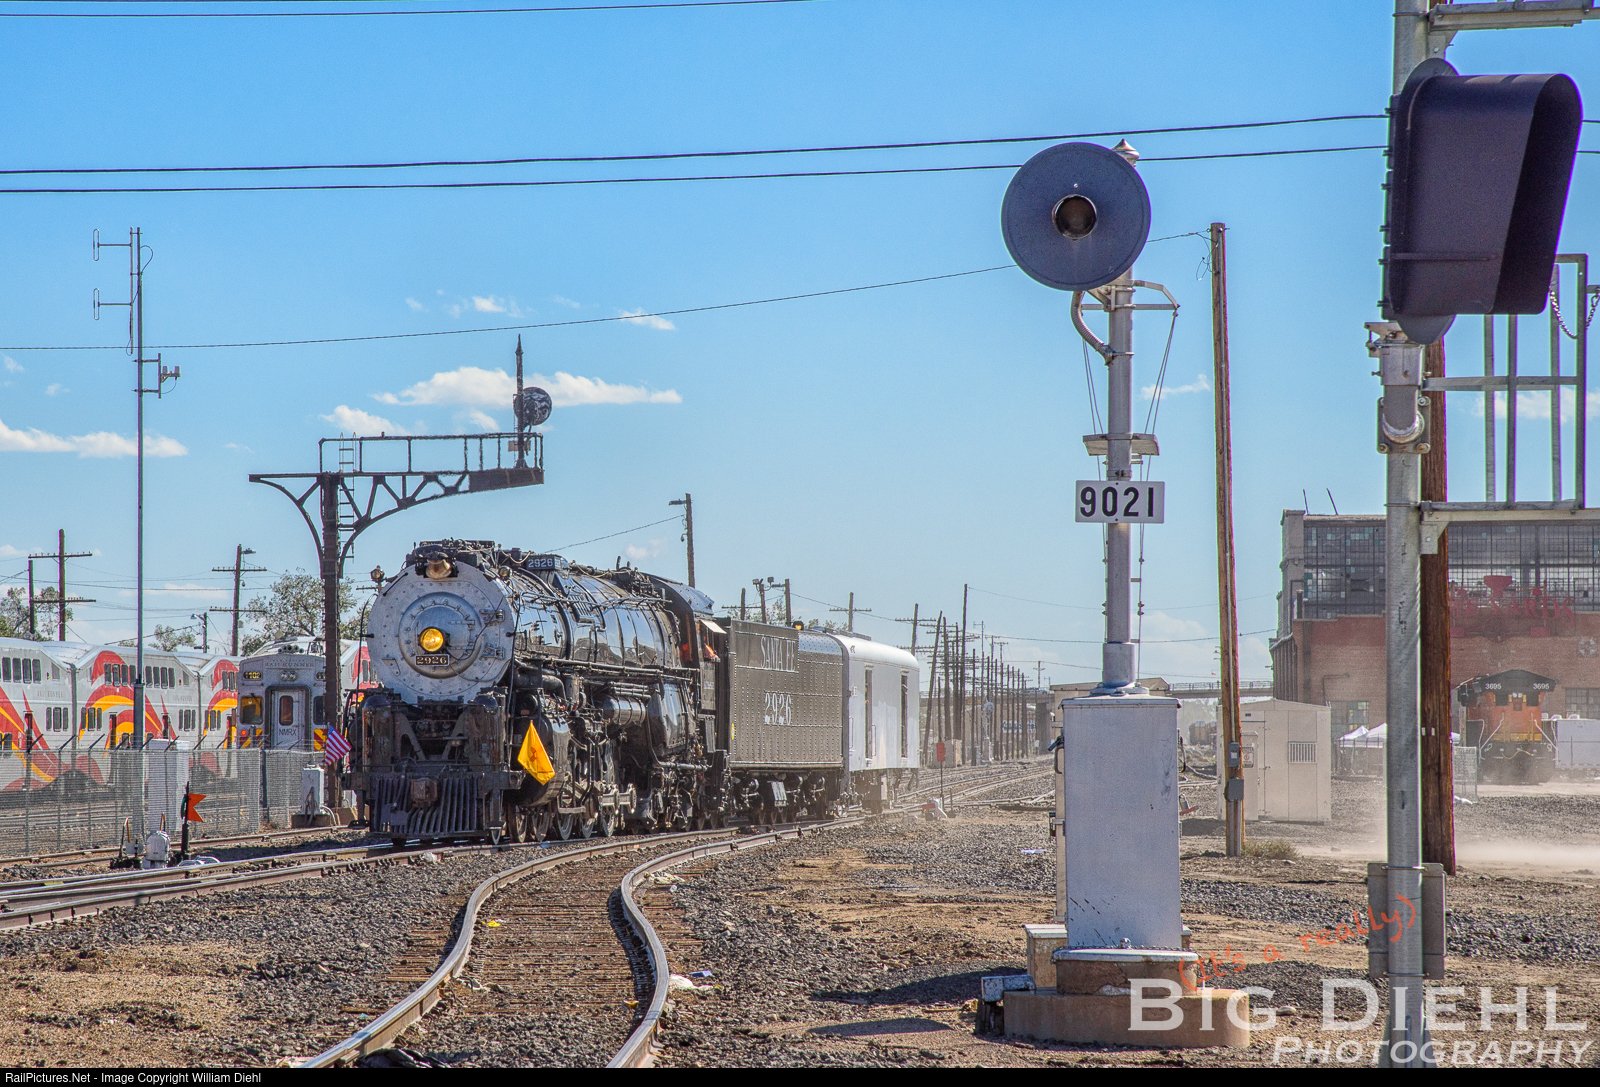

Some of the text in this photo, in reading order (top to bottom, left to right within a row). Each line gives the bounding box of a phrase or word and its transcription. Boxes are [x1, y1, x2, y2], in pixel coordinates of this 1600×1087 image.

[1079, 486, 1154, 517] 9021
[416, 656, 447, 665] 2926
[761, 636, 796, 672] SANTA FE
[763, 692, 792, 726] 2926
